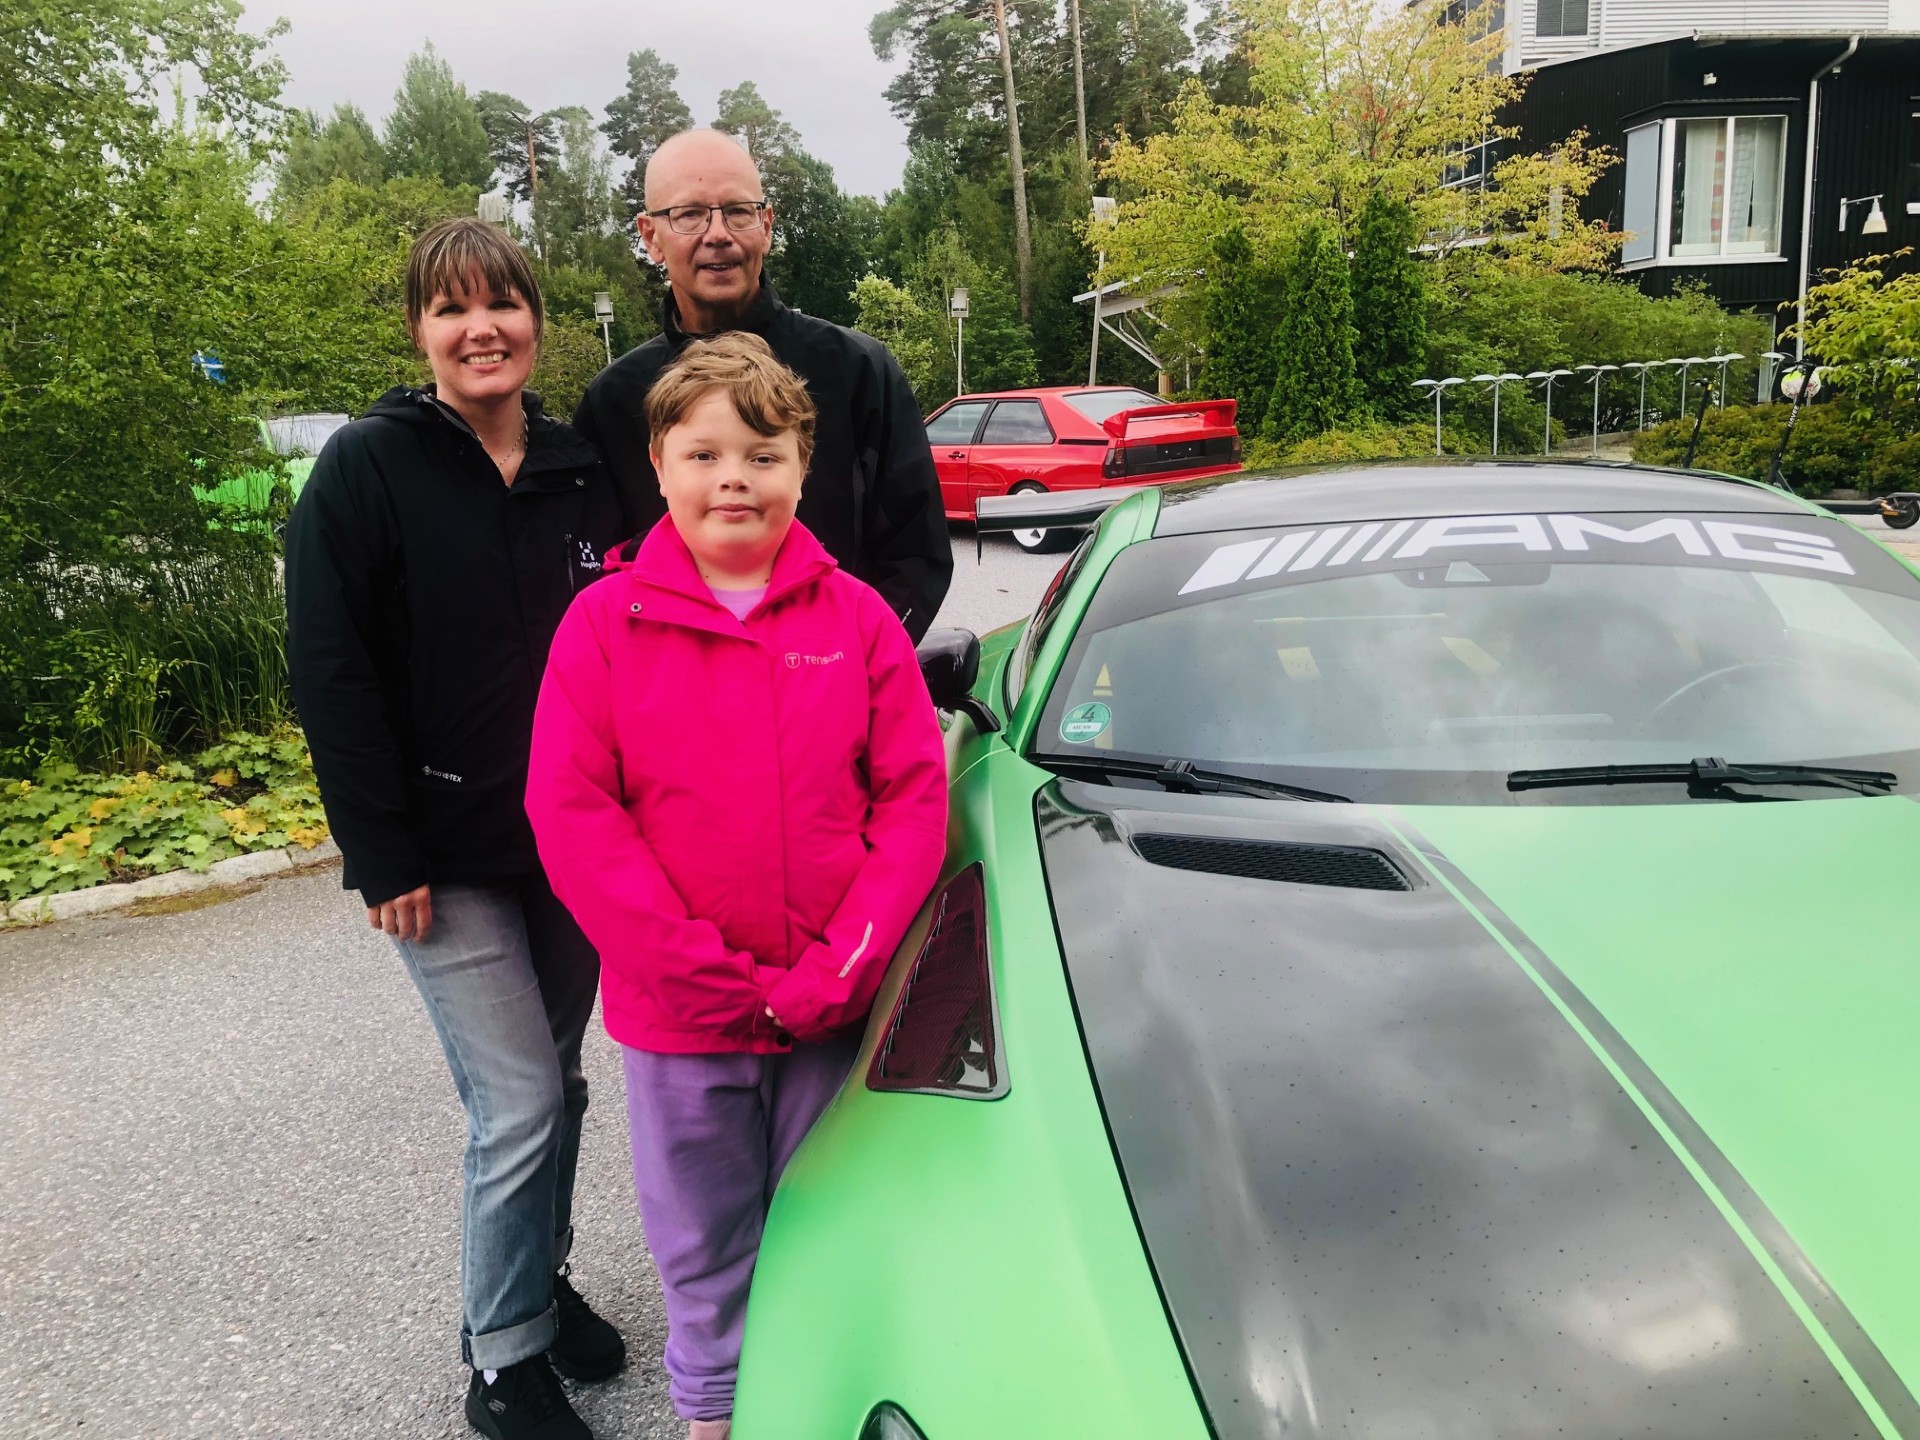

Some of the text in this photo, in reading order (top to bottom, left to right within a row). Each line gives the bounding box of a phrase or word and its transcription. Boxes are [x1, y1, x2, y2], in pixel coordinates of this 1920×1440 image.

[1392, 514, 1857, 576] AMG
[803, 651, 844, 665] Tenson
[1080, 704, 1097, 723] 4
